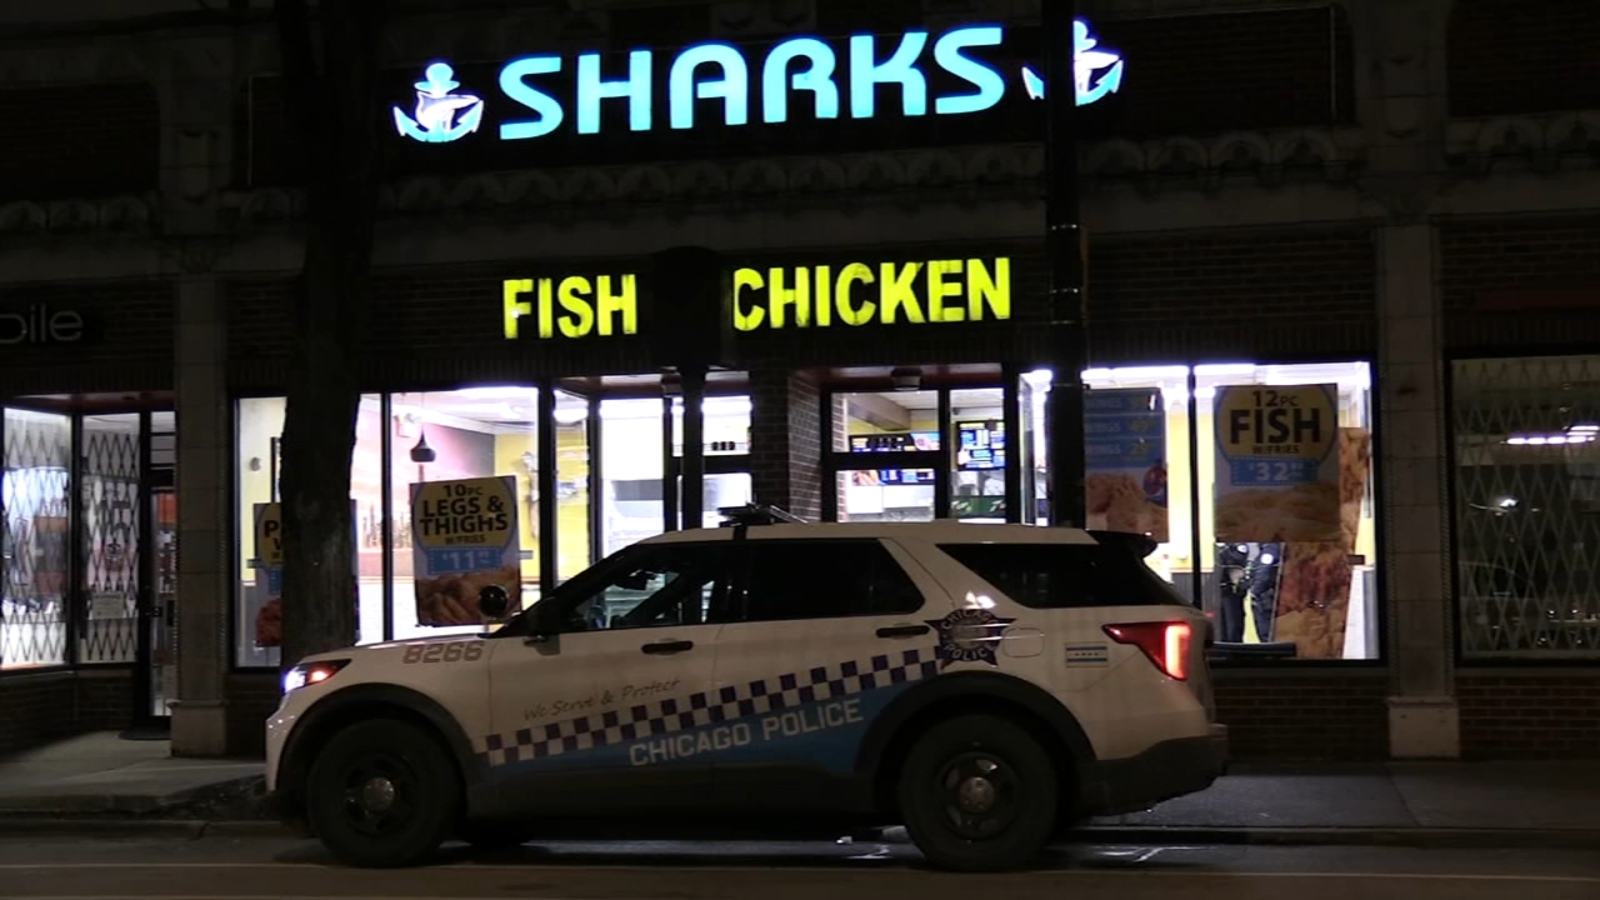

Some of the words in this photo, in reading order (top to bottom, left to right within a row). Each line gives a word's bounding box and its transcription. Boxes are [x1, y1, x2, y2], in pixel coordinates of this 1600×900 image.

[499, 26, 1005, 140] SHARKS
[503, 273, 637, 339] FISH
[732, 256, 1011, 331] CHICKEN
[1230, 408, 1321, 444] FISH
[419, 513, 508, 537] THIGHS
[423, 497, 481, 518] LEGS
[487, 495, 504, 513] &
[402, 640, 484, 664] 8266
[524, 704, 547, 721] We
[551, 697, 594, 716] Serve
[600, 690, 614, 705] &
[621, 676, 681, 699] Protect
[629, 722, 750, 767] CHICAGO
[761, 698, 864, 740] POLICE
